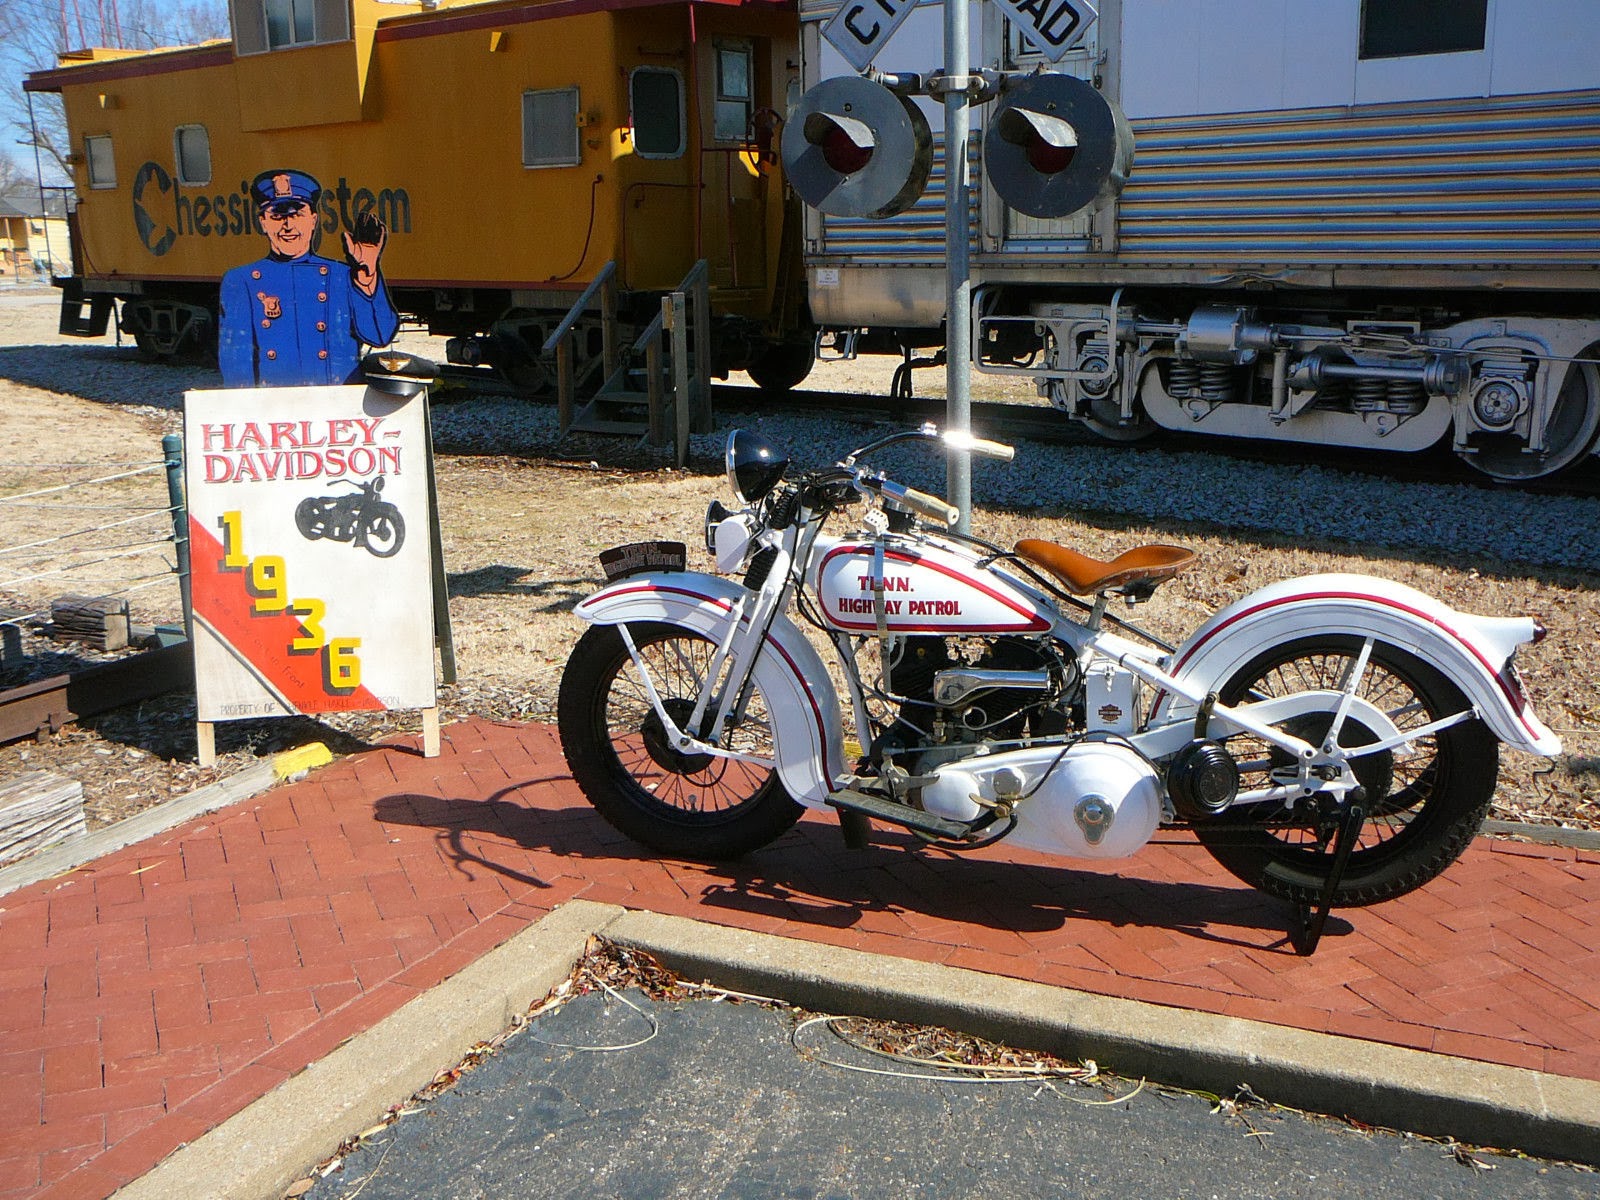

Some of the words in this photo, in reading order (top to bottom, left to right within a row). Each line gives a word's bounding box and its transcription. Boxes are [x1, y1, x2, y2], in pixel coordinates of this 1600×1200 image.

[1009, 0, 1080, 46] AD
[202, 418, 401, 452] HARLEY-
[203, 446, 402, 484] DAVIDSON
[839, 597, 902, 615] HIGHAY
[909, 600, 961, 615] PATROL
